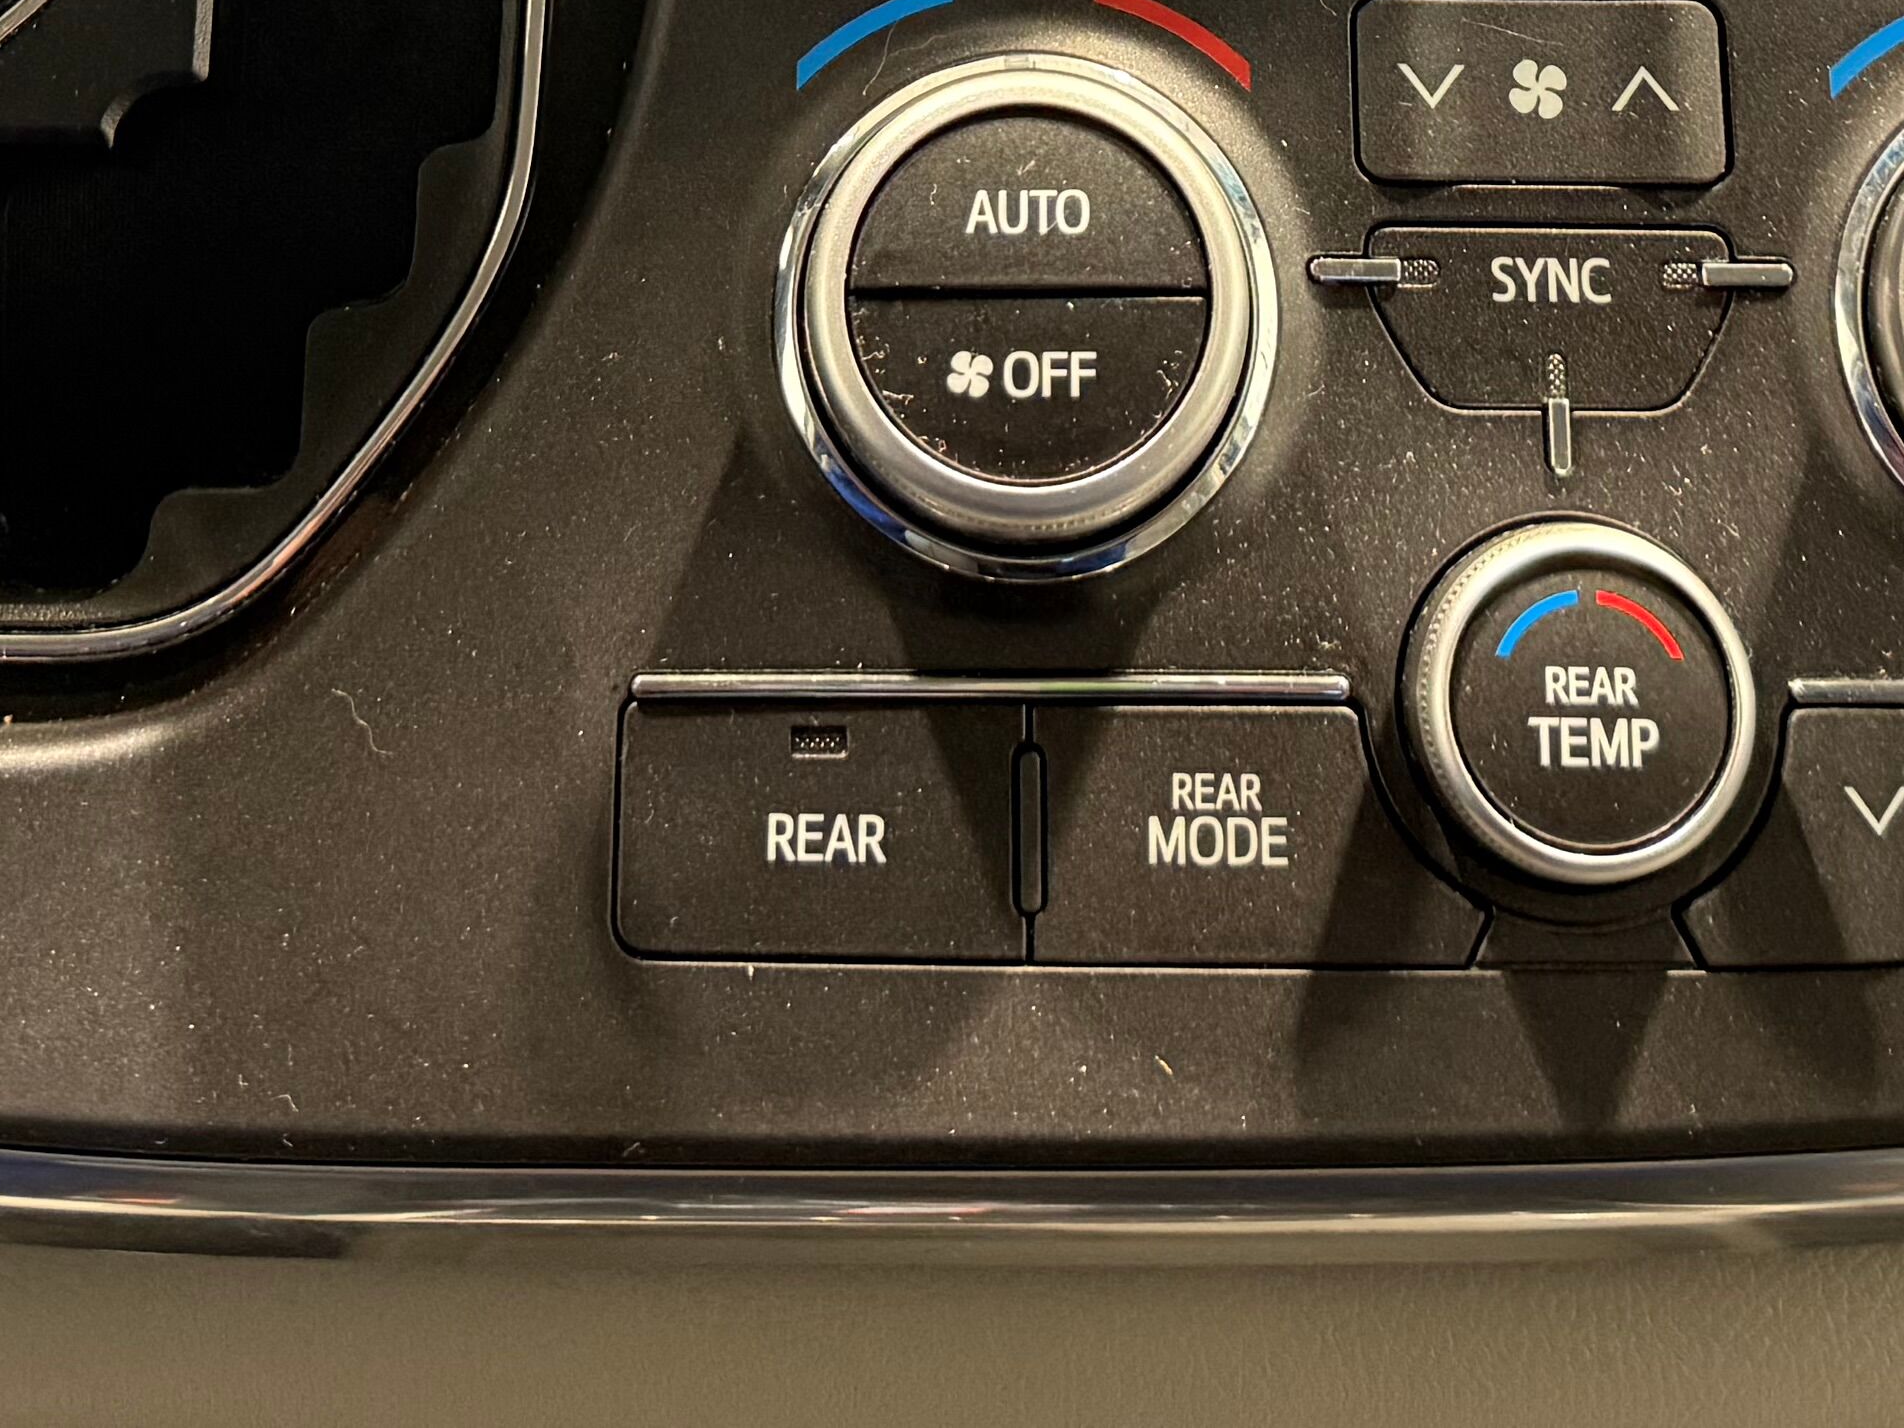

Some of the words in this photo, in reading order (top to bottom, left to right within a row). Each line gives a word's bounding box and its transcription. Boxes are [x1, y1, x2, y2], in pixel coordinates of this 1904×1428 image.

[965, 188, 1092, 235] AUTO
[1490, 255, 1614, 306] SYNC
[1002, 350, 1098, 399] OFF
[1545, 665, 1639, 707] REAR
[1528, 716, 1659, 769] TEMP
[1172, 772, 1262, 811] REAR
[767, 812, 887, 864] REAR
[1148, 815, 1289, 867] MODE
